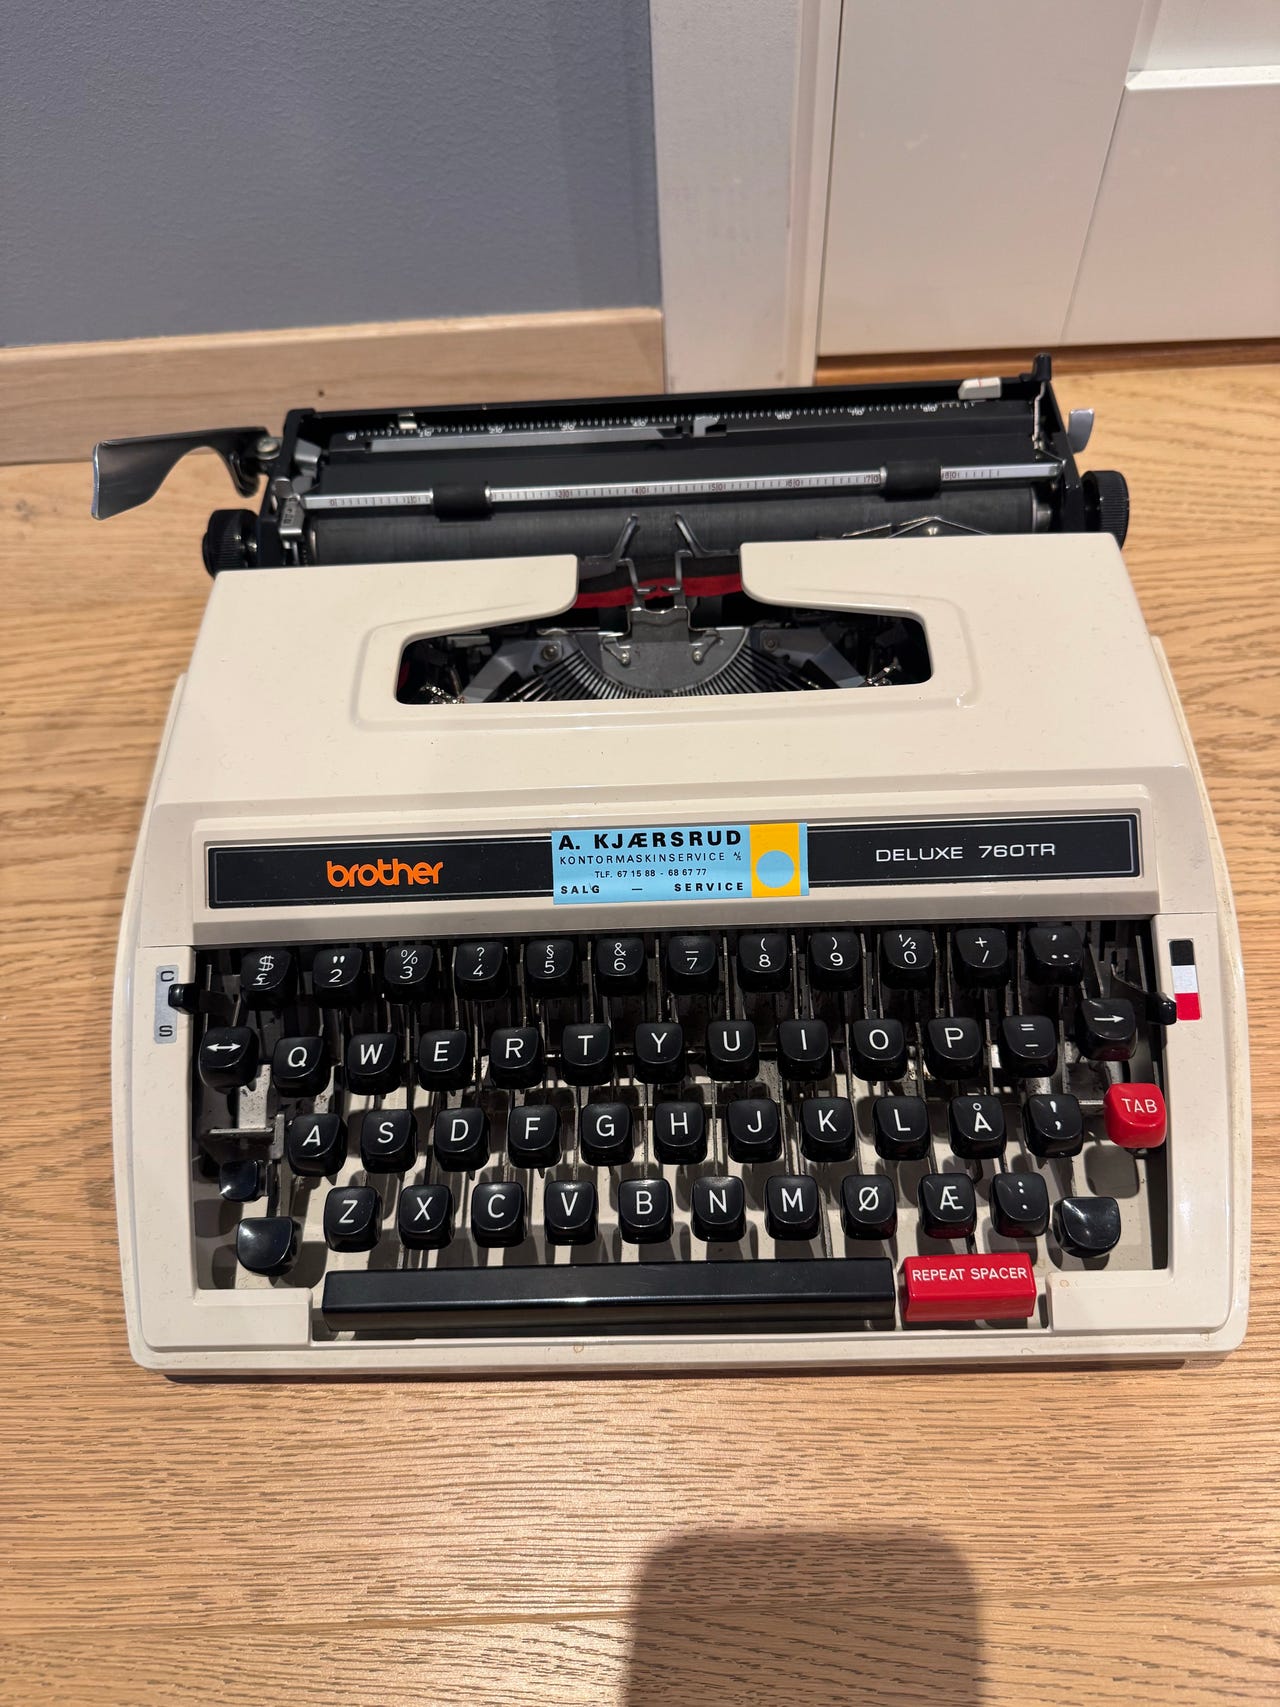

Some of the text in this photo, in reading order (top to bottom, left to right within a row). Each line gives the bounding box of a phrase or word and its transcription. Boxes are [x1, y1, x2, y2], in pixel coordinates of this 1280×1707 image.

[559, 831, 740, 850] A. KJÆRSRUD
[560, 853, 724, 864] KONTORMASKINSERVICE
[876, 844, 1056, 861] DELUXE 760TR
[327, 858, 443, 888] brother
[595, 871, 613, 879] TLF.
[561, 885, 599, 894] SALG
[675, 883, 743, 891] SERVICE
[547, 945, 554, 959] §
[614, 943, 626, 956] &
[761, 938, 766, 951] (
[832, 937, 837, 949] )
[976, 937, 987, 947] +
[259, 956, 273, 971] $
[401, 950, 417, 964] %
[477, 947, 484, 961] ?
[614, 958, 625, 970] 6
[687, 958, 697, 969] 7
[759, 954, 771, 967] 8
[831, 953, 843, 966] 9
[161, 971, 174, 982] C
[329, 969, 342, 982] 2
[400, 966, 412, 979] 3
[473, 964, 483, 976] 4
[544, 961, 554, 973] 5
[159, 1025, 172, 1037] S
[724, 1031, 740, 1051] U
[801, 1030, 807, 1050] I
[869, 1029, 888, 1049] O
[945, 1028, 963, 1048] P
[434, 1041, 449, 1061] E
[506, 1039, 523, 1058] R
[578, 1035, 593, 1055] T
[652, 1033, 667, 1052] Y
[288, 1047, 307, 1067] Q
[361, 1044, 383, 1064] W
[1122, 1099, 1157, 1113] TAB
[597, 1115, 614, 1136] G
[671, 1112, 688, 1135] H
[748, 1111, 761, 1132] J
[819, 1110, 836, 1131] K
[894, 1109, 910, 1131] L
[973, 1103, 992, 1132] Å
[303, 1125, 320, 1146] A
[378, 1122, 393, 1143] S
[451, 1119, 468, 1141] D
[526, 1118, 540, 1139] F
[488, 1194, 505, 1218] C
[561, 1192, 578, 1216] V
[637, 1191, 652, 1214] B
[709, 1190, 726, 1213] N
[782, 1188, 803, 1212] M
[859, 1187, 878, 1211] Ø
[940, 1186, 963, 1209] Æ
[340, 1201, 358, 1223] Z
[414, 1197, 432, 1220] X
[912, 1268, 1027, 1281] REPEAT SPACER
